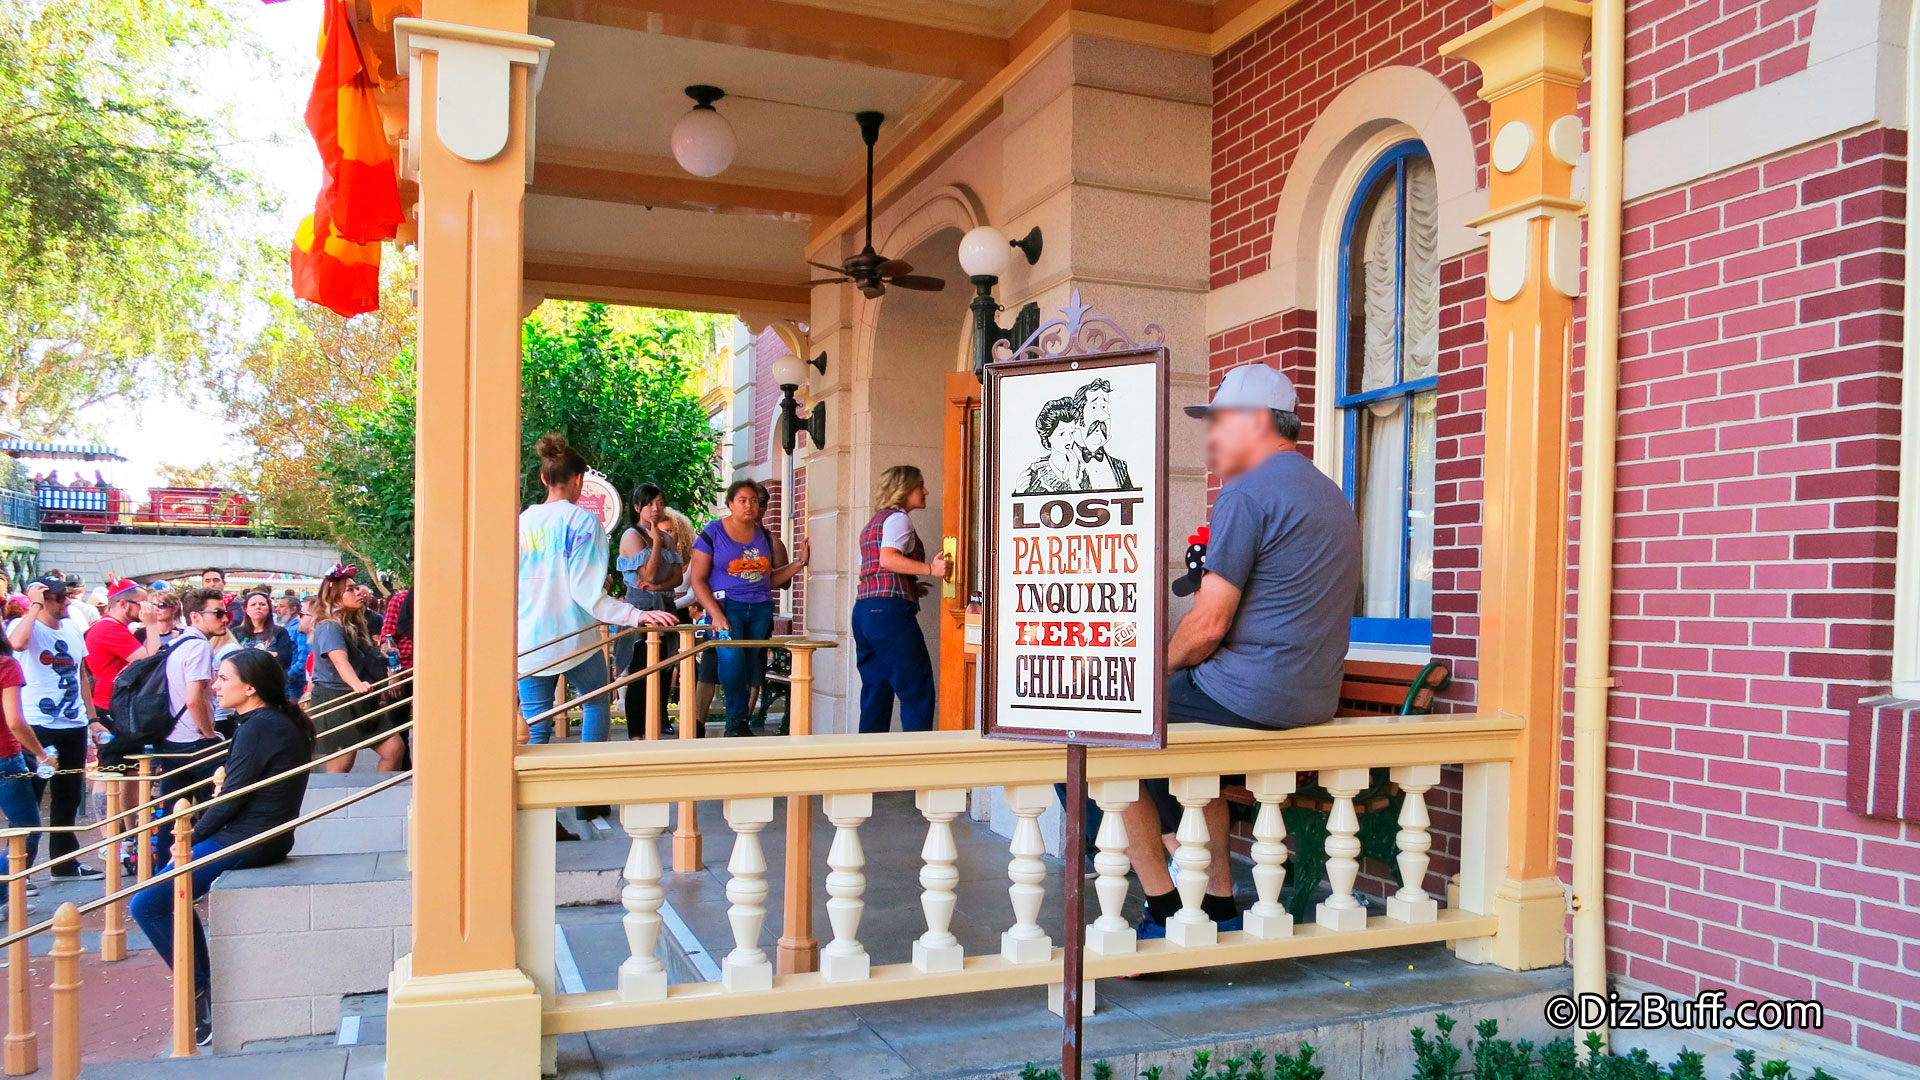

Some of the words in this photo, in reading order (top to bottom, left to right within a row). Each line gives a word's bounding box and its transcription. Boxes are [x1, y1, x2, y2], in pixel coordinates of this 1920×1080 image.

[1013, 498, 1144, 529] LOST
[1012, 533, 1138, 574] PARENTS
[1015, 582, 1137, 613] INQUIRE
[1015, 621, 1111, 647] HERE
[1114, 624, 1135, 643] FOR
[1016, 654, 1137, 701] CHILDREN
